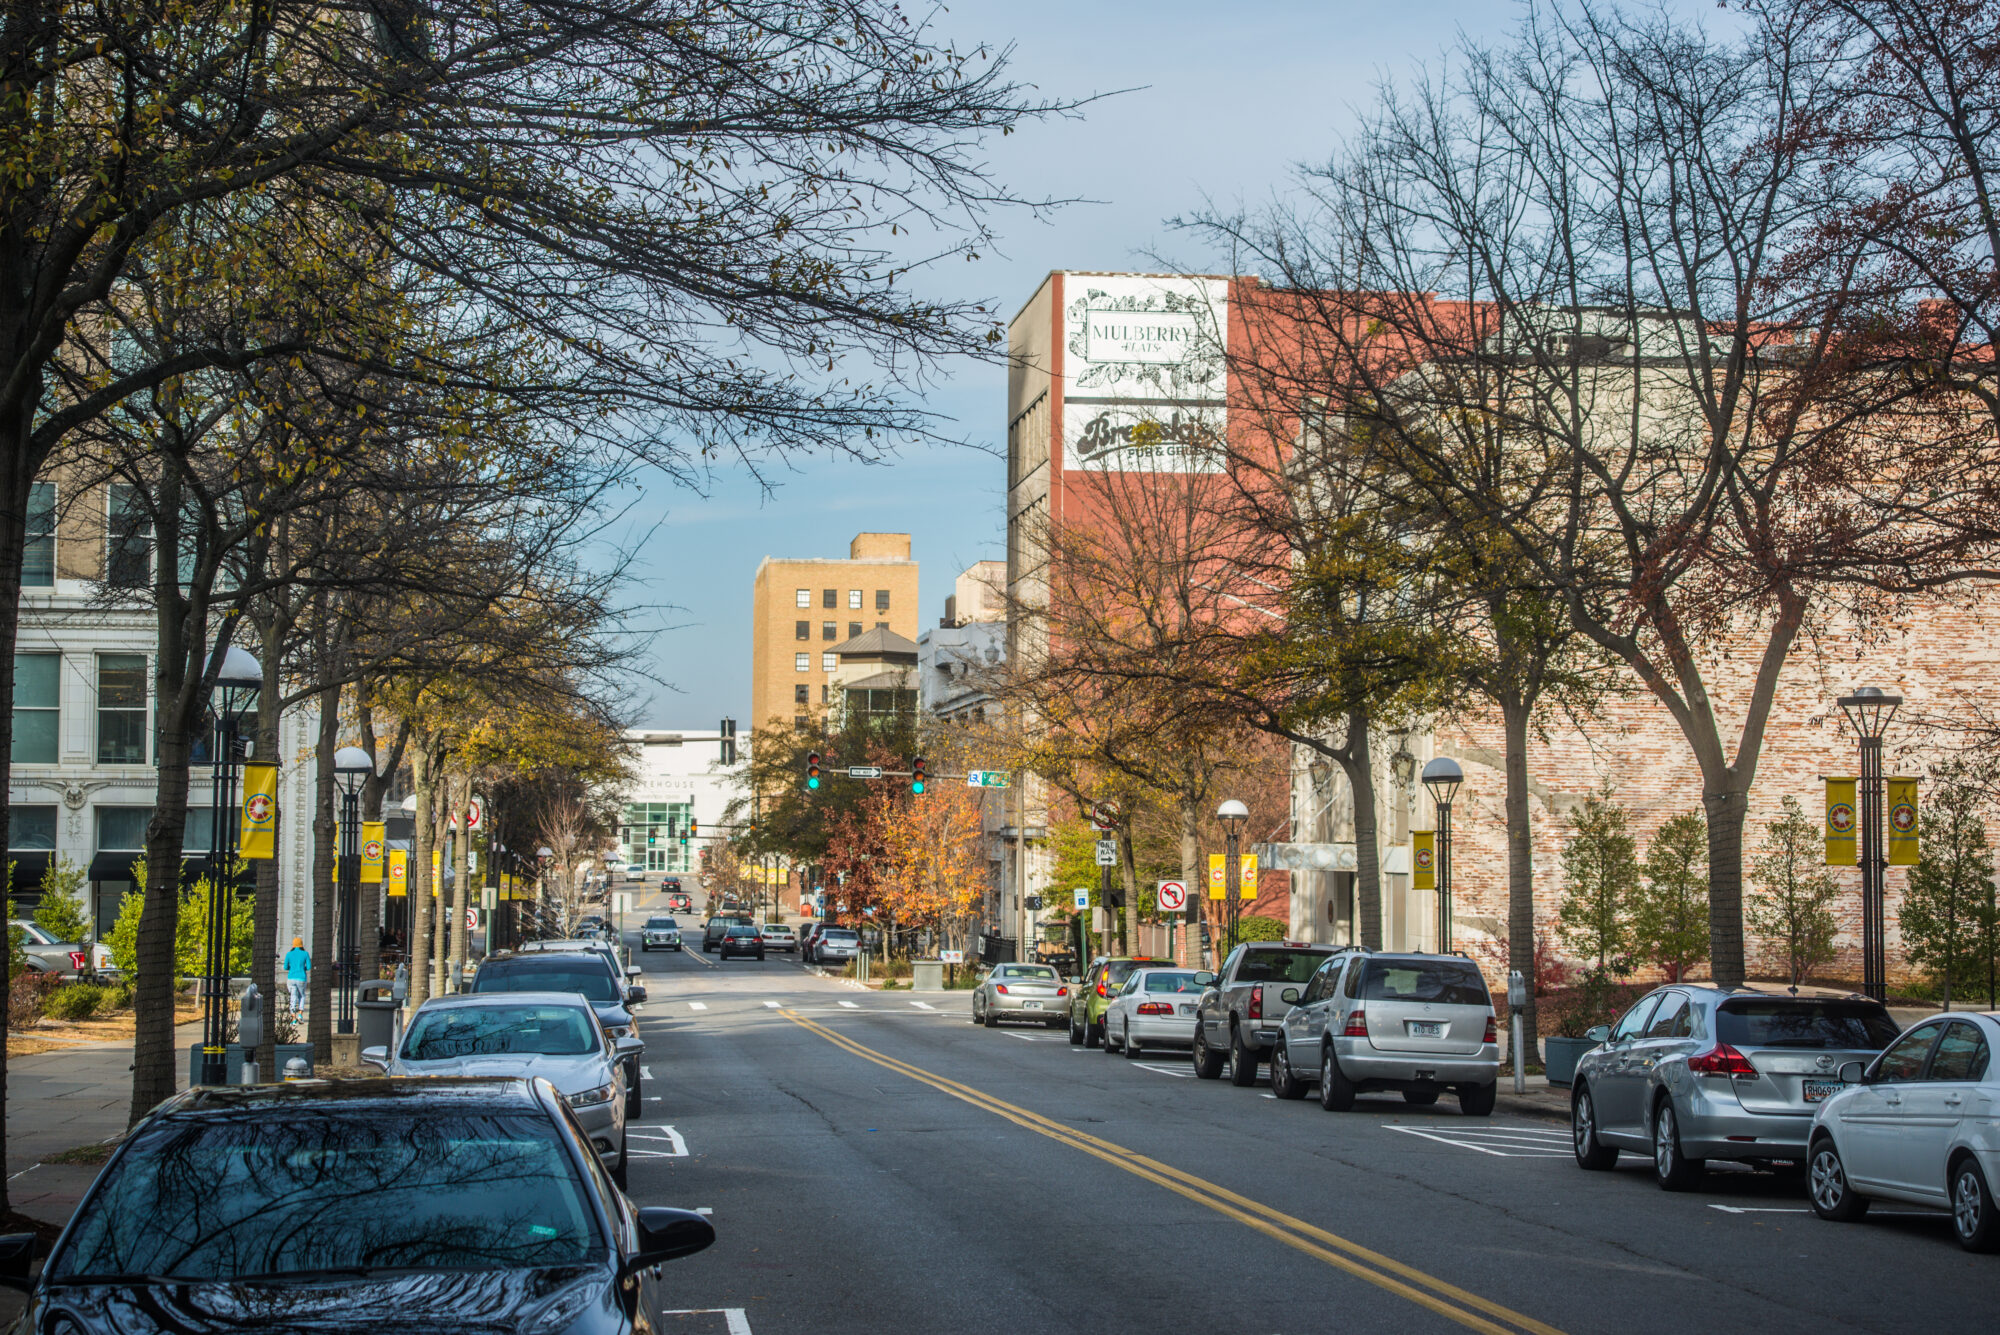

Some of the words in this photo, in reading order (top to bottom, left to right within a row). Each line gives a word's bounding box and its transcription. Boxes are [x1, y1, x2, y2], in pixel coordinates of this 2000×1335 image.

[1093, 325, 1191, 342] MULBERRY
[1127, 446, 1154, 458] PUB
[1155, 446, 1165, 457] &
